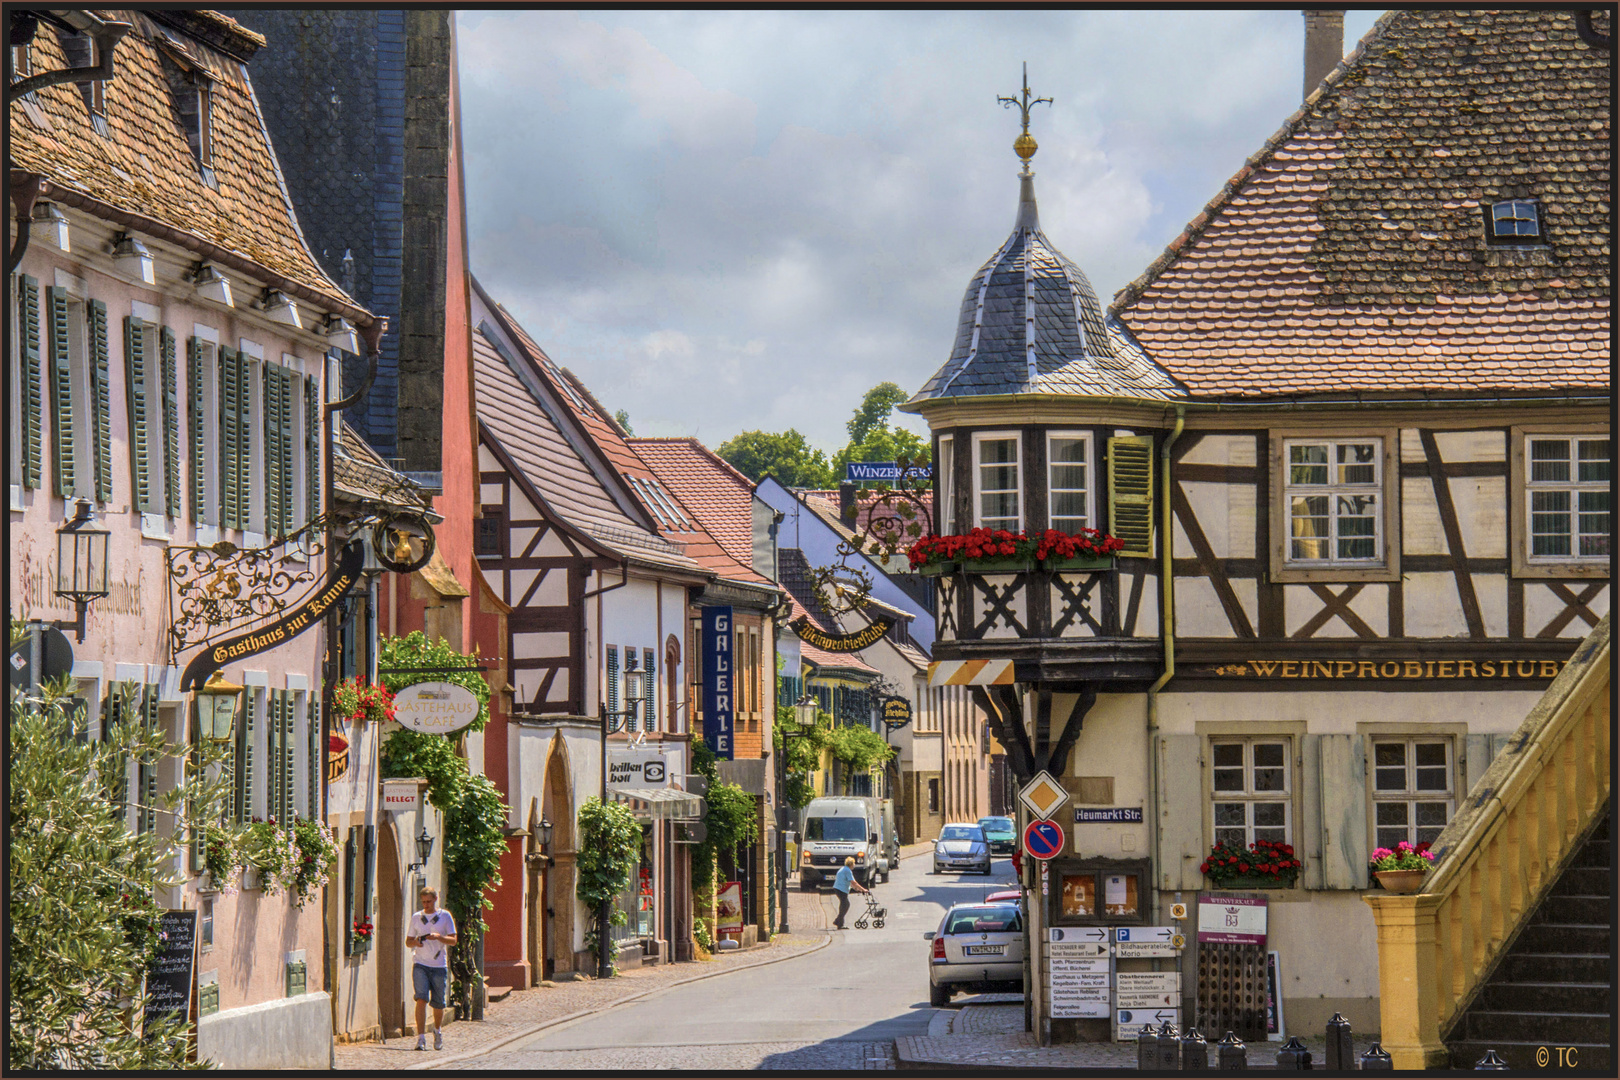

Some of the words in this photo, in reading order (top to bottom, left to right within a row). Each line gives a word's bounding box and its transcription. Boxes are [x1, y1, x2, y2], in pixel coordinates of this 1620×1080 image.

[213, 626, 285, 663] Gasthaus
[288, 612, 309, 636] zur
[306, 574, 351, 617] Kanne
[1247, 660, 1569, 678] WEINPROBIERSTUB
[715, 615, 729, 752] GALERIE
[413, 718, 421, 726] &
[423, 714, 455, 726] CAFÉ
[609, 762, 642, 772] brillen
[609, 773, 631, 783] bott
[1076, 810, 1123, 820] Heumarkt
[1124, 809, 1141, 820] Str.
[1119, 931, 1128, 941] P
